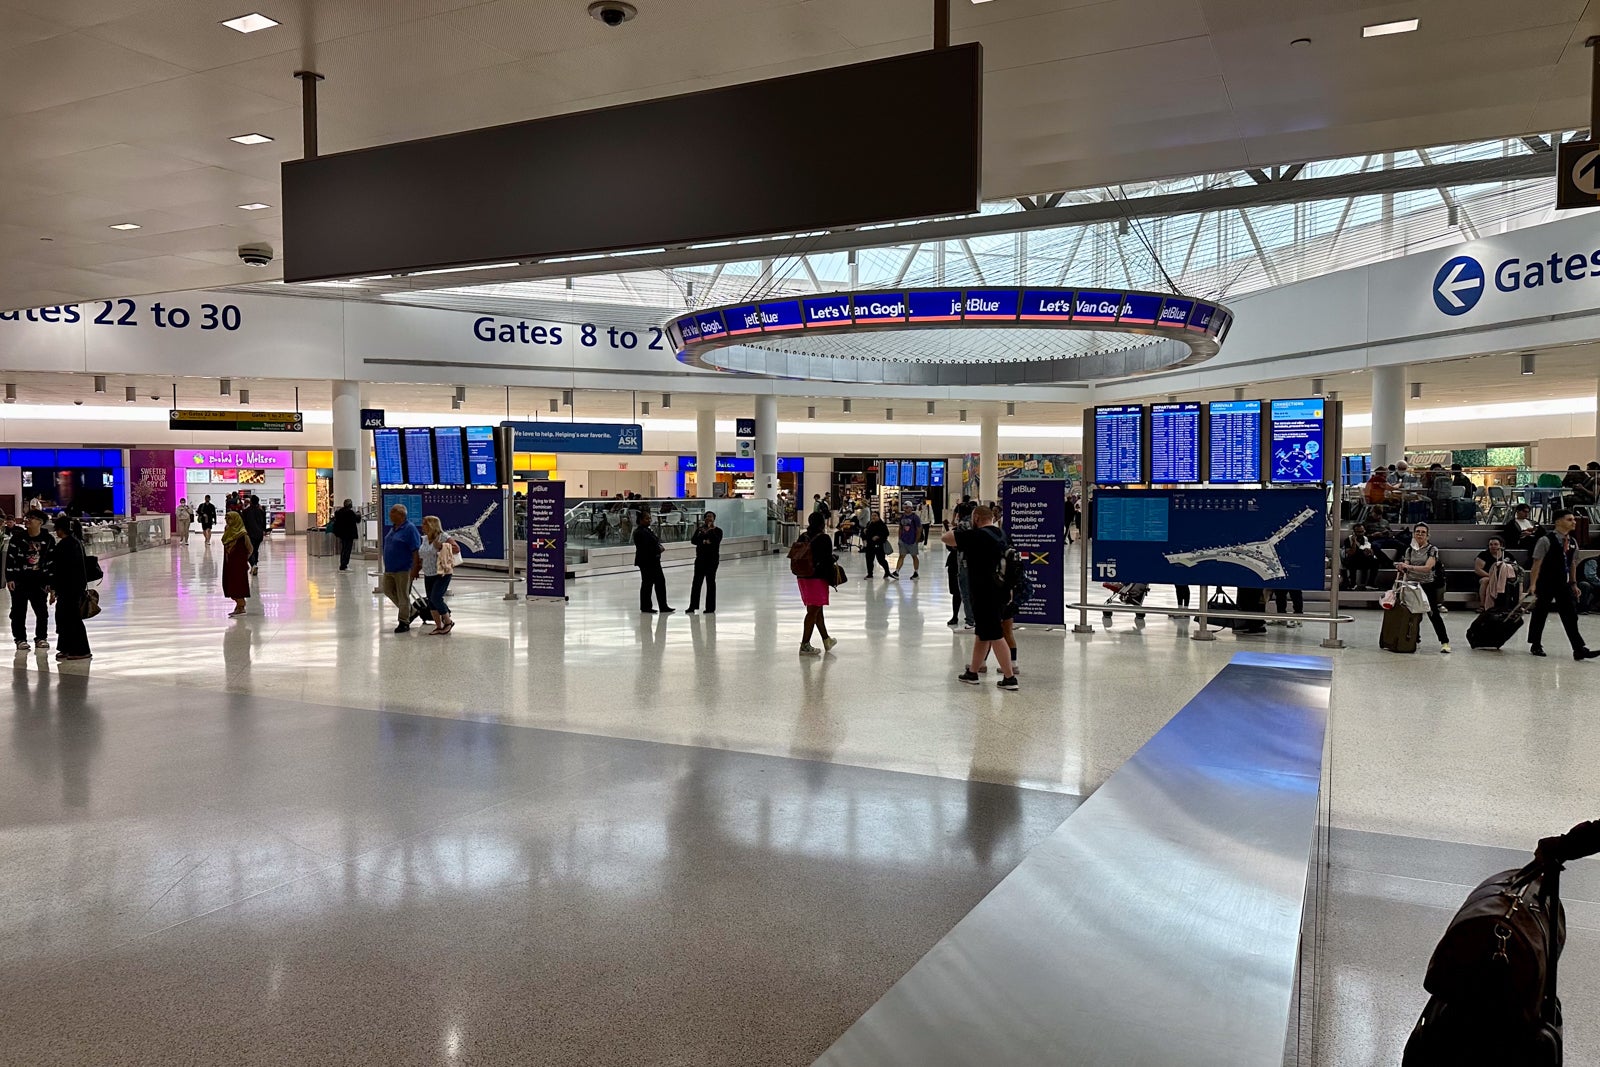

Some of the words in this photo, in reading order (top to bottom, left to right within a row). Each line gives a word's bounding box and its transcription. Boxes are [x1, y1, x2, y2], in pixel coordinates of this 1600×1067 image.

[1494, 249, 1600, 292] Gates
[810, 304, 839, 320] Let's
[870, 302, 914, 317] Gogh.
[950, 298, 999, 314] jetBlue
[1039, 300, 1070, 312] Let's
[1076, 300, 1098, 313] Van
[1098, 301, 1133, 316] Gogh.
[1158, 305, 1186, 320] jetBlue
[94, 299, 137, 326] 22
[150, 302, 190, 328] to
[200, 304, 241, 330] 30
[744, 312, 778, 328] jetBlue
[474, 316, 562, 345] Gates
[580, 324, 597, 347] 8
[606, 325, 638, 349] to
[700, 320, 722, 334] Gogh.
[618, 428, 638, 436] JUST
[618, 436, 638, 445] ASK
[1011, 485, 1036, 494] jetBlue
[1096, 564, 1116, 578] T5
